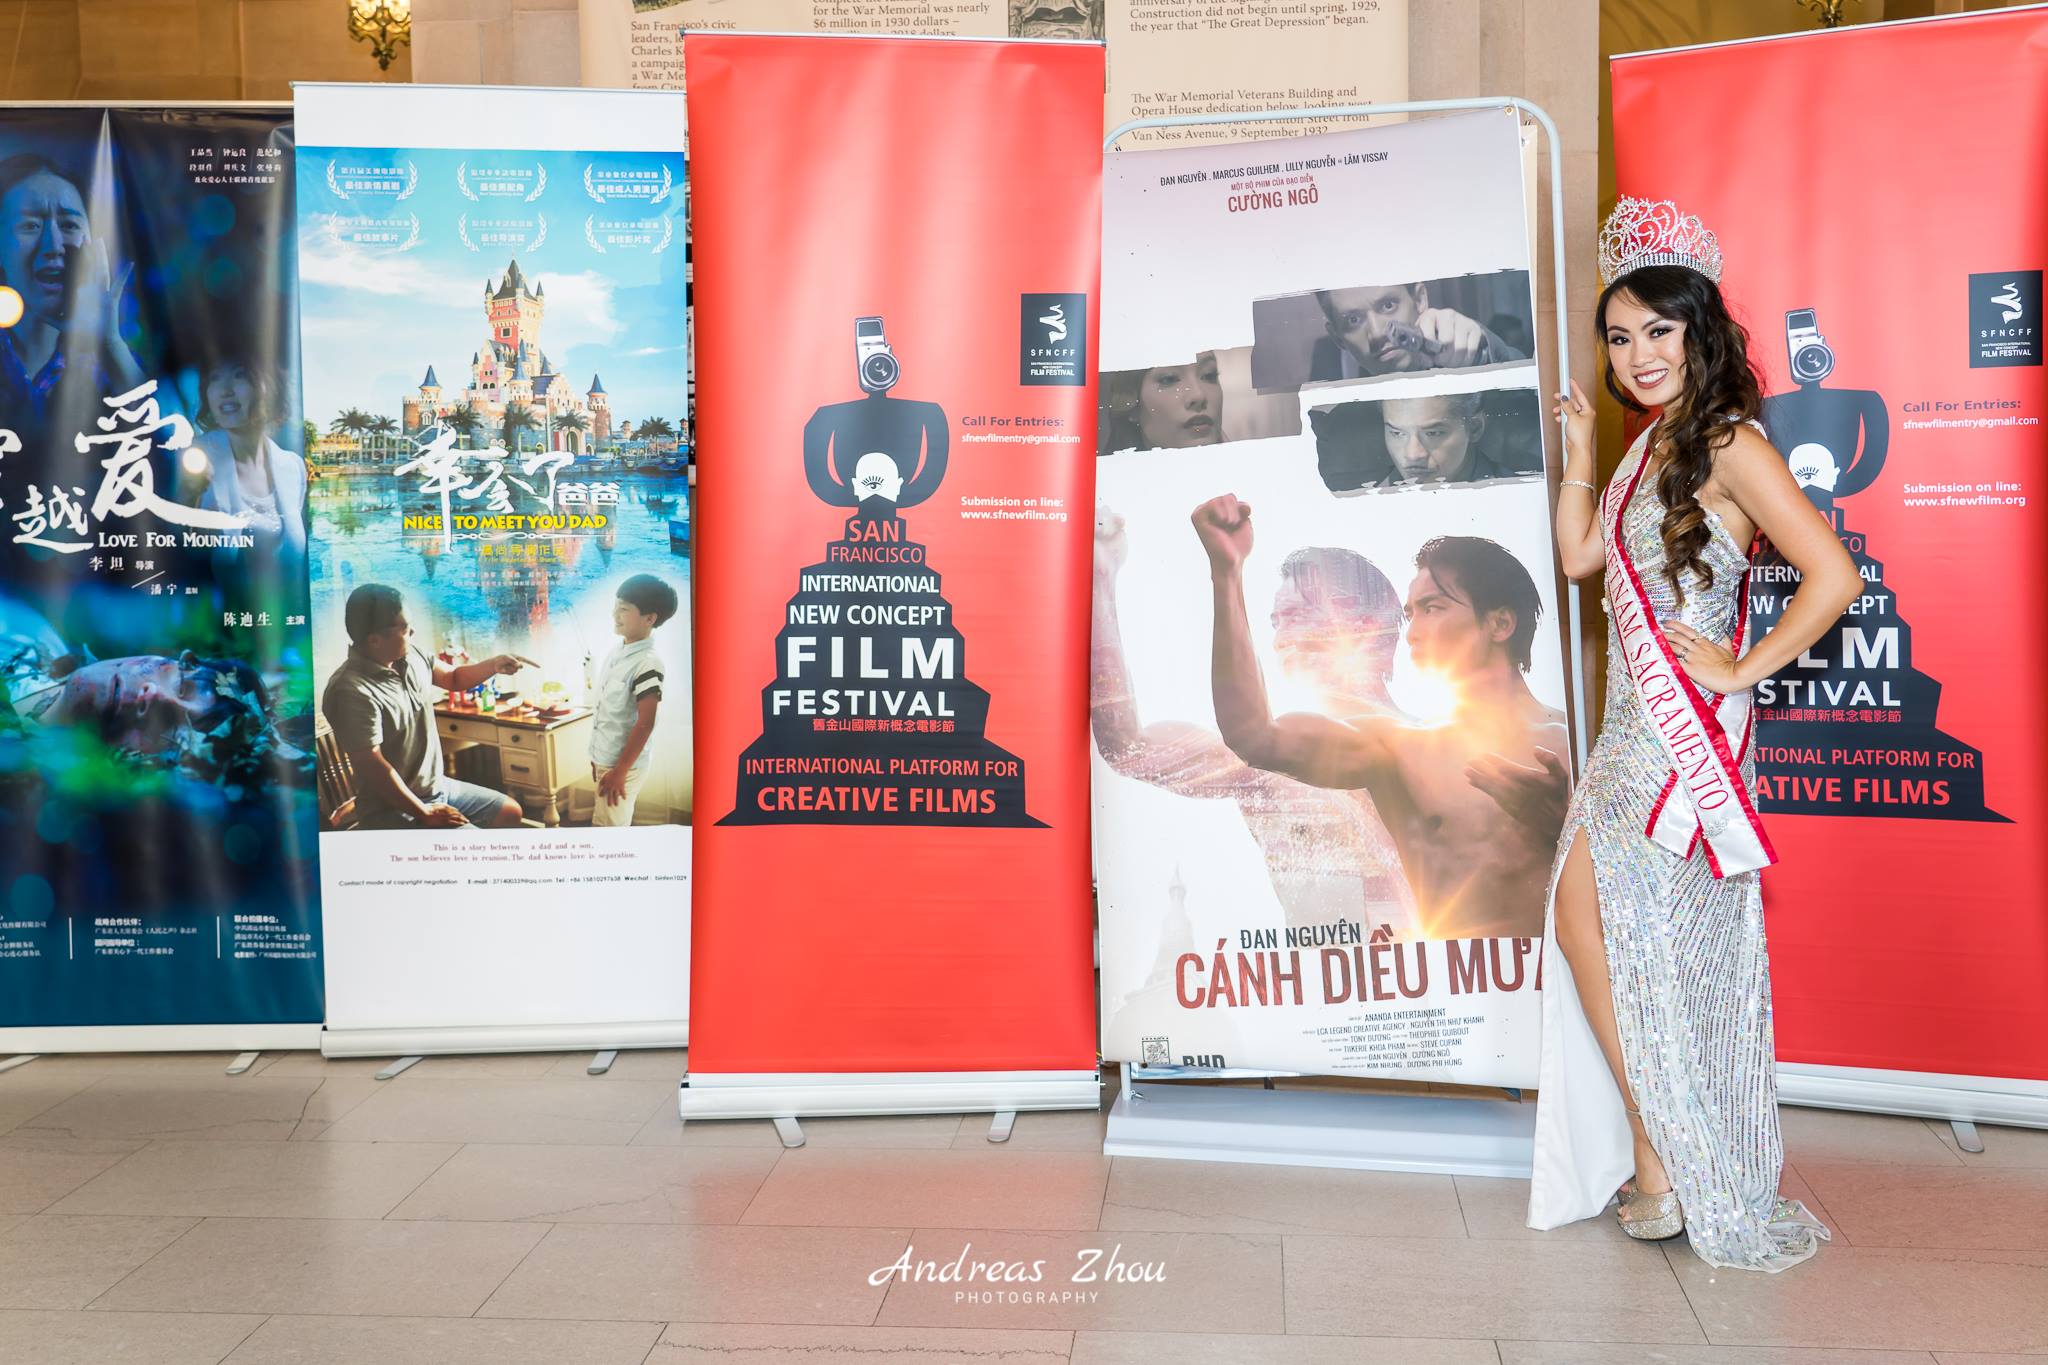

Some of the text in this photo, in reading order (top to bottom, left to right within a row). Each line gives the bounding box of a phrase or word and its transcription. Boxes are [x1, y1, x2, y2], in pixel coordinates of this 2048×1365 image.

[813, 2, 991, 17] for the War Memorial was nearly
[1130, 7, 1202, 20] Construction
[1205, 6, 1224, 18] did
[1226, 6, 1245, 17] not
[1248, 4, 1278, 16] begin
[1281, 3, 1307, 15] until
[1310, 3, 1348, 15] spring,
[1352, 0, 1381, 12] 1929,
[631, 19, 736, 31] San Francisco's civic
[813, 16, 950, 29] $6 million in 1930 dollars
[1130, 21, 1148, 33] the
[1150, 22, 1174, 34] year
[1176, 19, 1199, 31] that
[1230, 17, 1261, 29] Great
[1333, 14, 1370, 27] began.
[631, 33, 673, 44] leaders,
[631, 46, 672, 56] Charles
[641, 70, 664, 81] War
[1131, 86, 1357, 104] The War Memorial Veterans Building and
[1131, 102, 1263, 118] Opera House dedication
[1131, 130, 1153, 141] Van
[1156, 129, 1181, 141] Ness
[1185, 128, 1228, 140] Avenue,
[1231, 128, 1238, 138] 9
[1240, 126, 1299, 140] September
[1213, 167, 1245, 181] MARCUS
[1246, 163, 1280, 177] GUILHEM
[1285, 161, 1304, 172] LILLY
[1361, 151, 1389, 164] VISSAY
[1255, 179, 1271, 189] PHIM
[1227, 183, 1319, 213] CƯỜNG NGÔ
[1981, 328, 2032, 338] SFNCFF
[1981, 349, 2032, 358] FILM FESTIVAL
[1903, 399, 2021, 413] Call For Entries:
[961, 416, 1065, 427] Call For Entries:
[1903, 416, 2038, 430] sfnewfilmentry@gmail.com
[961, 433, 1081, 445] sfnewfilmentry@gmail.com
[1903, 482, 2022, 494] Submission on line:
[961, 495, 1064, 508] Submission on line:
[1903, 495, 2026, 507] www.sfnewfilm.org
[404, 514, 607, 530] NICE TO MEET YOU DAD
[960, 509, 1068, 523] www.sfnewfilm.org
[848, 519, 899, 543] SAN
[830, 546, 923, 564] FRANCISCO
[802, 574, 940, 594] INTERNATIONAL
[789, 604, 946, 626] NEW CONCEPT
[787, 636, 955, 680] FILM
[1758, 679, 1901, 707] STIVAL
[772, 689, 955, 717] FESTIVAL
[812, 718, 955, 733] 舊金山國際新概念電影節
[1630, 642, 1729, 812] SACRAMENTO
[1831, 749, 1975, 769] PLATFORM FOR
[745, 758, 1018, 777] INTERNATIONAL PLATFORM FOR
[1755, 775, 1951, 806] ATIVE FILMS
[757, 786, 996, 815] CREATIVE FILMS
[490, 843, 520, 851] between
[555, 842, 568, 850] and
[528, 853, 541, 861] dad
[545, 852, 567, 860] knows
[339, 879, 365, 887] Contact
[393, 879, 423, 887] copyright
[1240, 919, 1362, 949] ĐAN NGUYÊN
[1175, 923, 1543, 1010] CÁNH DIỀU MƯ
[1364, 1012, 1392, 1022] ANANDA
[1393, 1008, 1446, 1021] ENTERTAINMENT
[1330, 1026, 1352, 1035] LEGEND
[1353, 1024, 1381, 1034] CREATIVE
